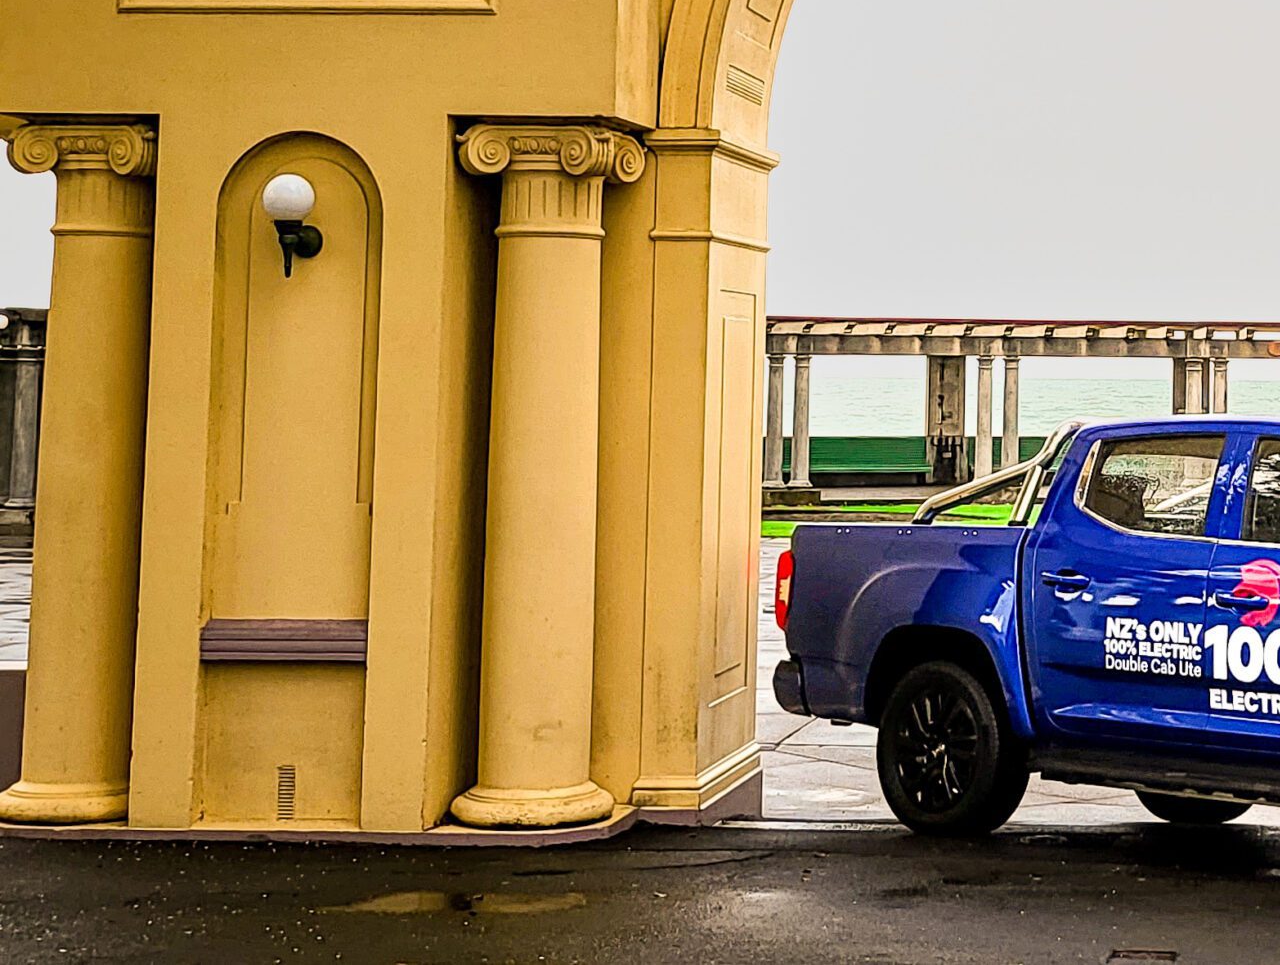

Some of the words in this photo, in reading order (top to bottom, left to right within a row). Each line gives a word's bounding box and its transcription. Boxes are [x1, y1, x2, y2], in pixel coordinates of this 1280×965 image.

[1105, 616, 1147, 640] NZ's
[1149, 620, 1203, 645] ONLY
[1103, 638, 1137, 656] 100%
[1138, 641, 1202, 661] ELECTRIC
[1105, 654, 1149, 673] Double
[1149, 659, 1177, 676] Cab
[1179, 663, 1202, 678] Ute
